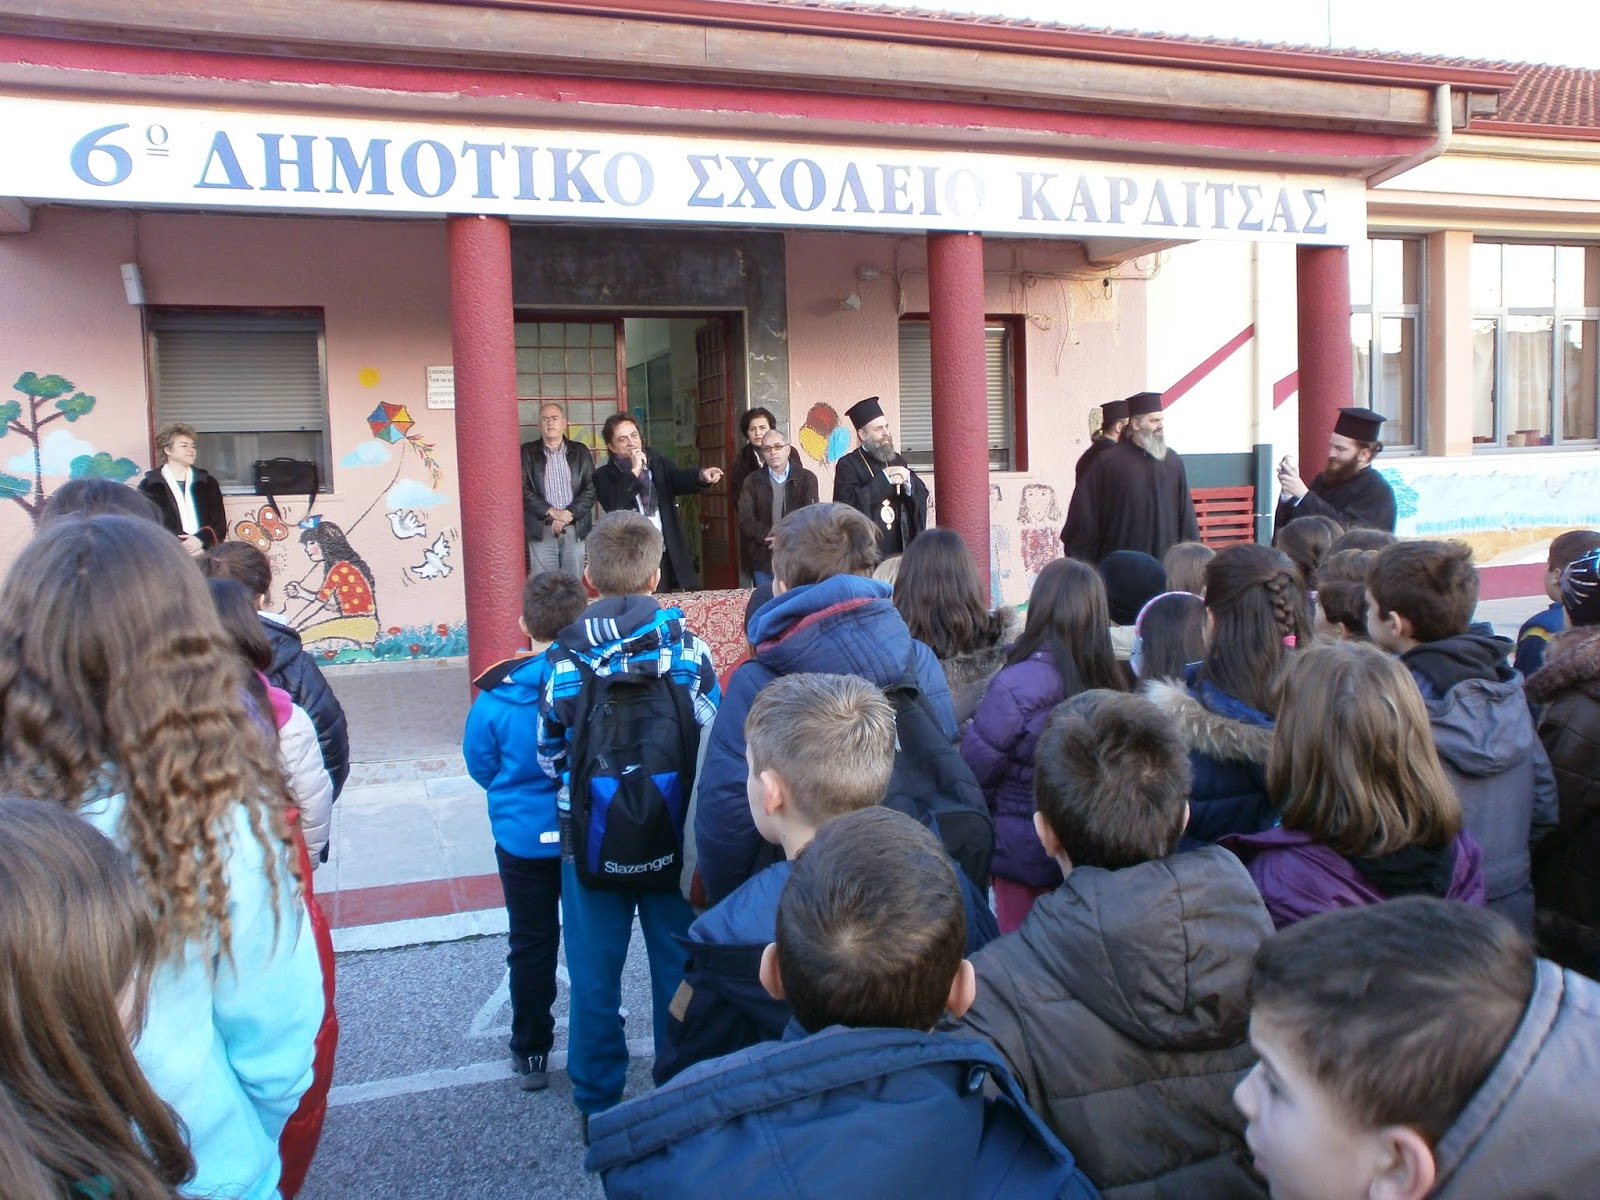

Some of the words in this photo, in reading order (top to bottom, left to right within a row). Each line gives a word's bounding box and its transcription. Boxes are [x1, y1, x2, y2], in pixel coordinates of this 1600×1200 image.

[192, 130, 655, 207] ΔΗΜΟΤΙΚΟ
[1015, 170, 1329, 235] ΚΑΡΔΙΤΣΑΣ
[604, 852, 675, 874] Slazenger
